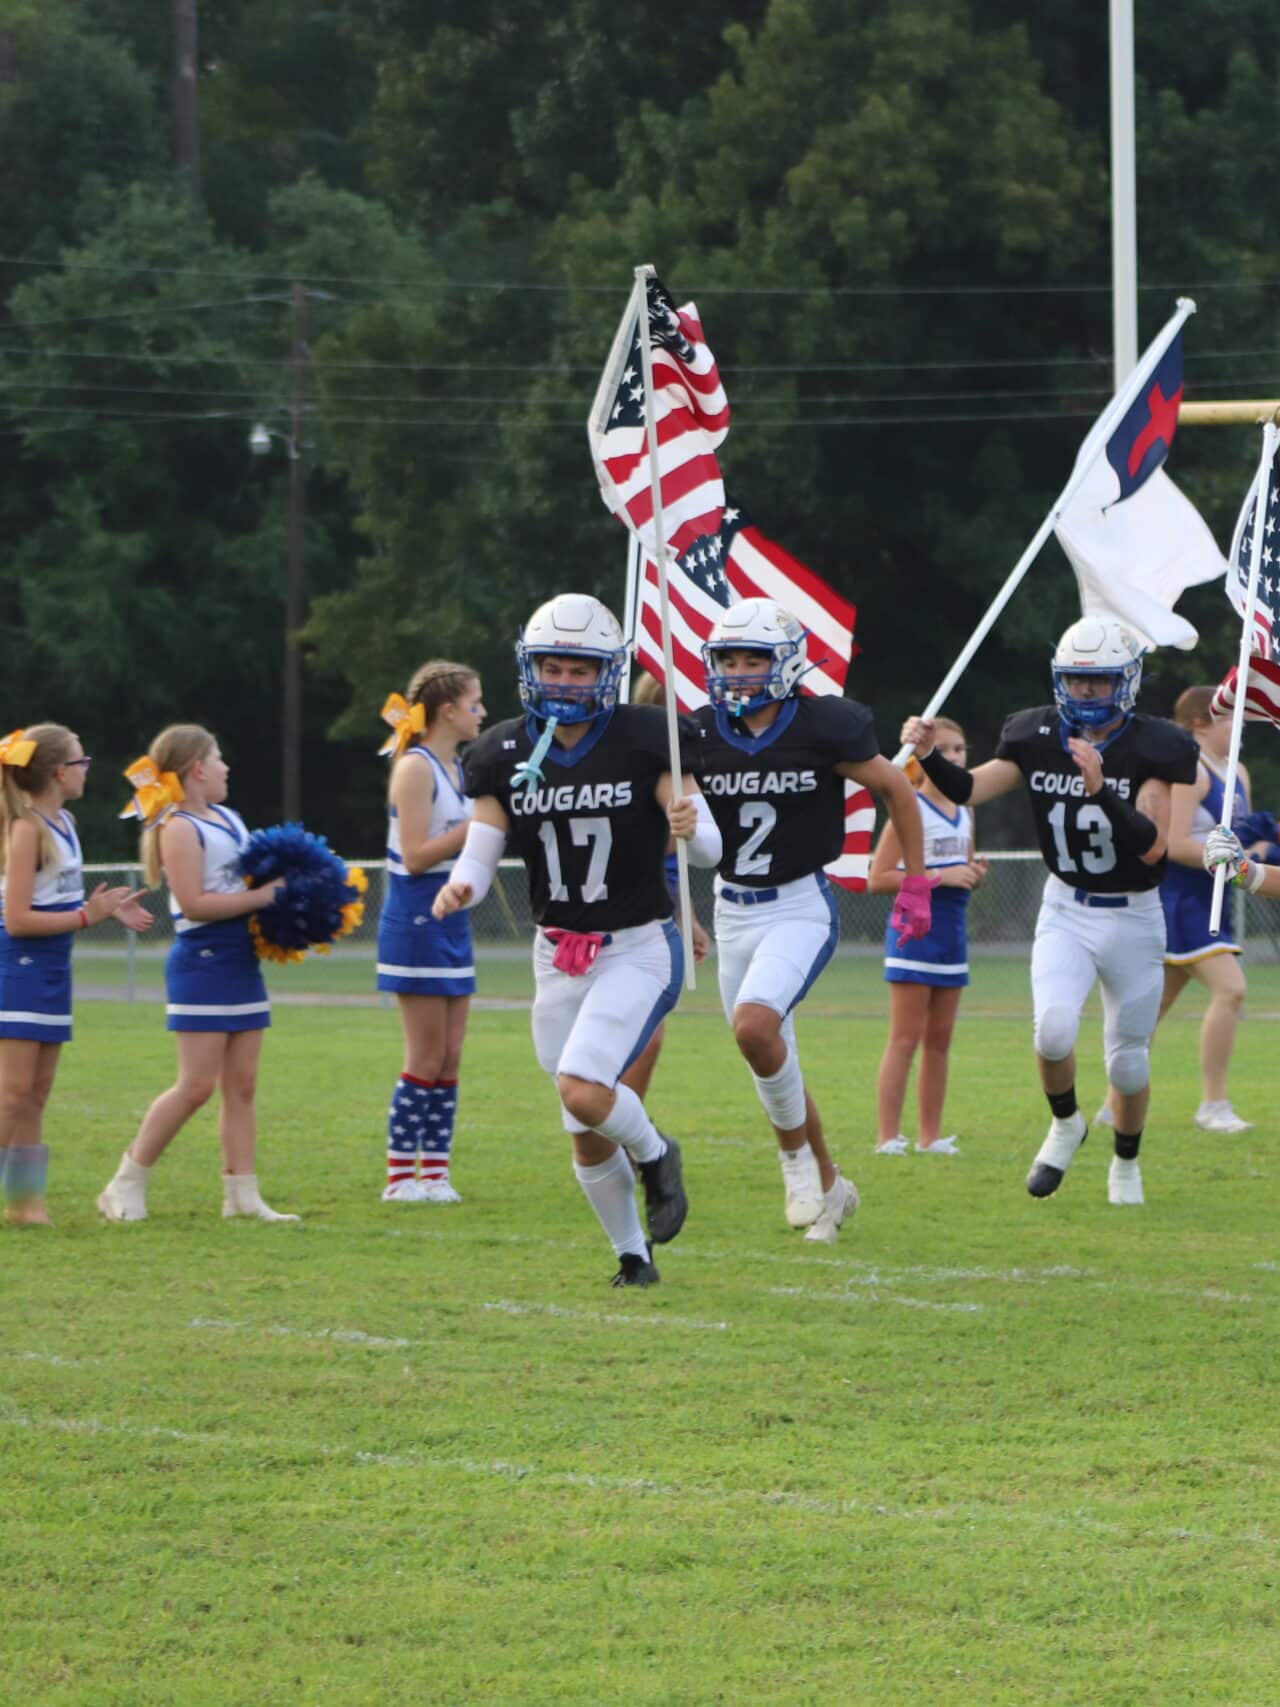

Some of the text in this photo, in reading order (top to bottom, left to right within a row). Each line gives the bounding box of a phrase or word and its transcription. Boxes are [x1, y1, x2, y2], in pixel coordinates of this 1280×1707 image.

[511, 781, 632, 816] COUGARS
[1030, 771, 1131, 799] COUGRS
[538, 817, 613, 903] 17
[734, 801, 777, 876] 2
[1047, 801, 1117, 874] 13
